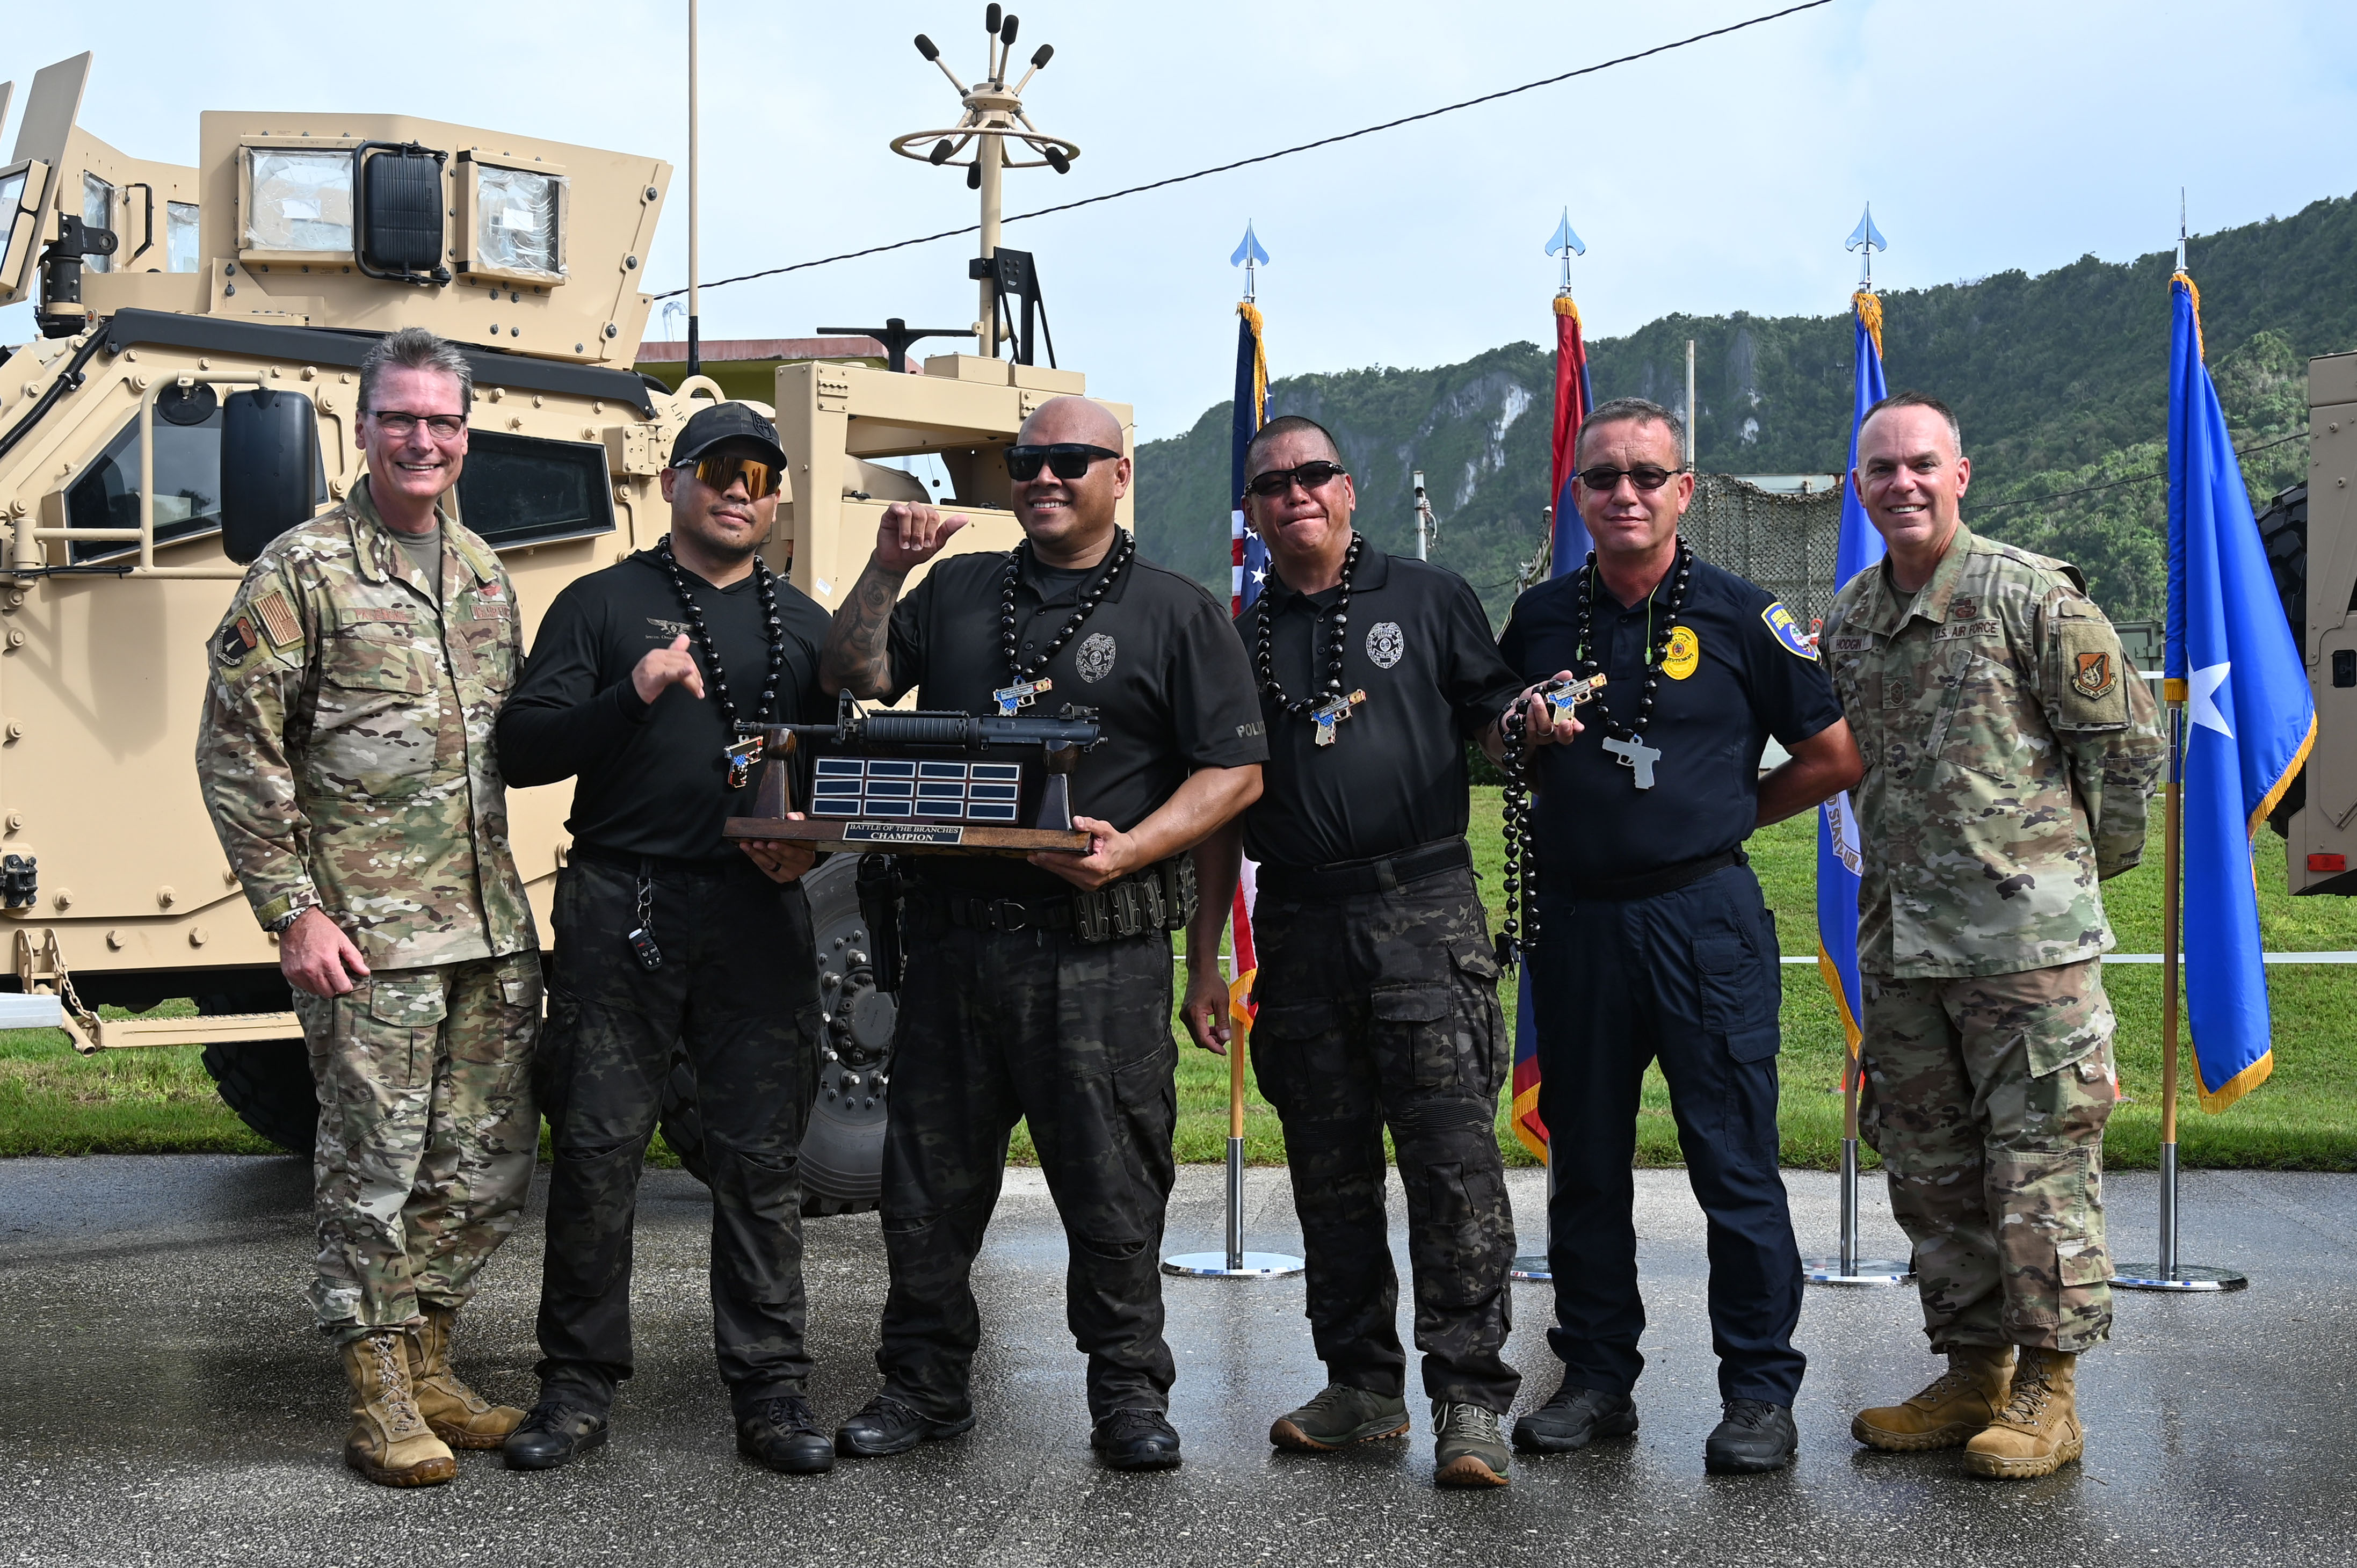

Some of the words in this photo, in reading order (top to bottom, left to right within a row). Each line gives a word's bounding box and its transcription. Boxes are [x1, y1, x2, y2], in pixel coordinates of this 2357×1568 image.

[1935, 629, 1947, 640] U.S.
[1952, 626, 1966, 637] AIR
[1969, 621, 1997, 635] FORCE
[1836, 638, 1862, 649] HODGIN
[1666, 653, 1694, 662] IEUTENANT
[1084, 663, 1102, 671] POLICE
[871, 832, 934, 841] CHAMPION
[1828, 808, 1843, 856] STATE
